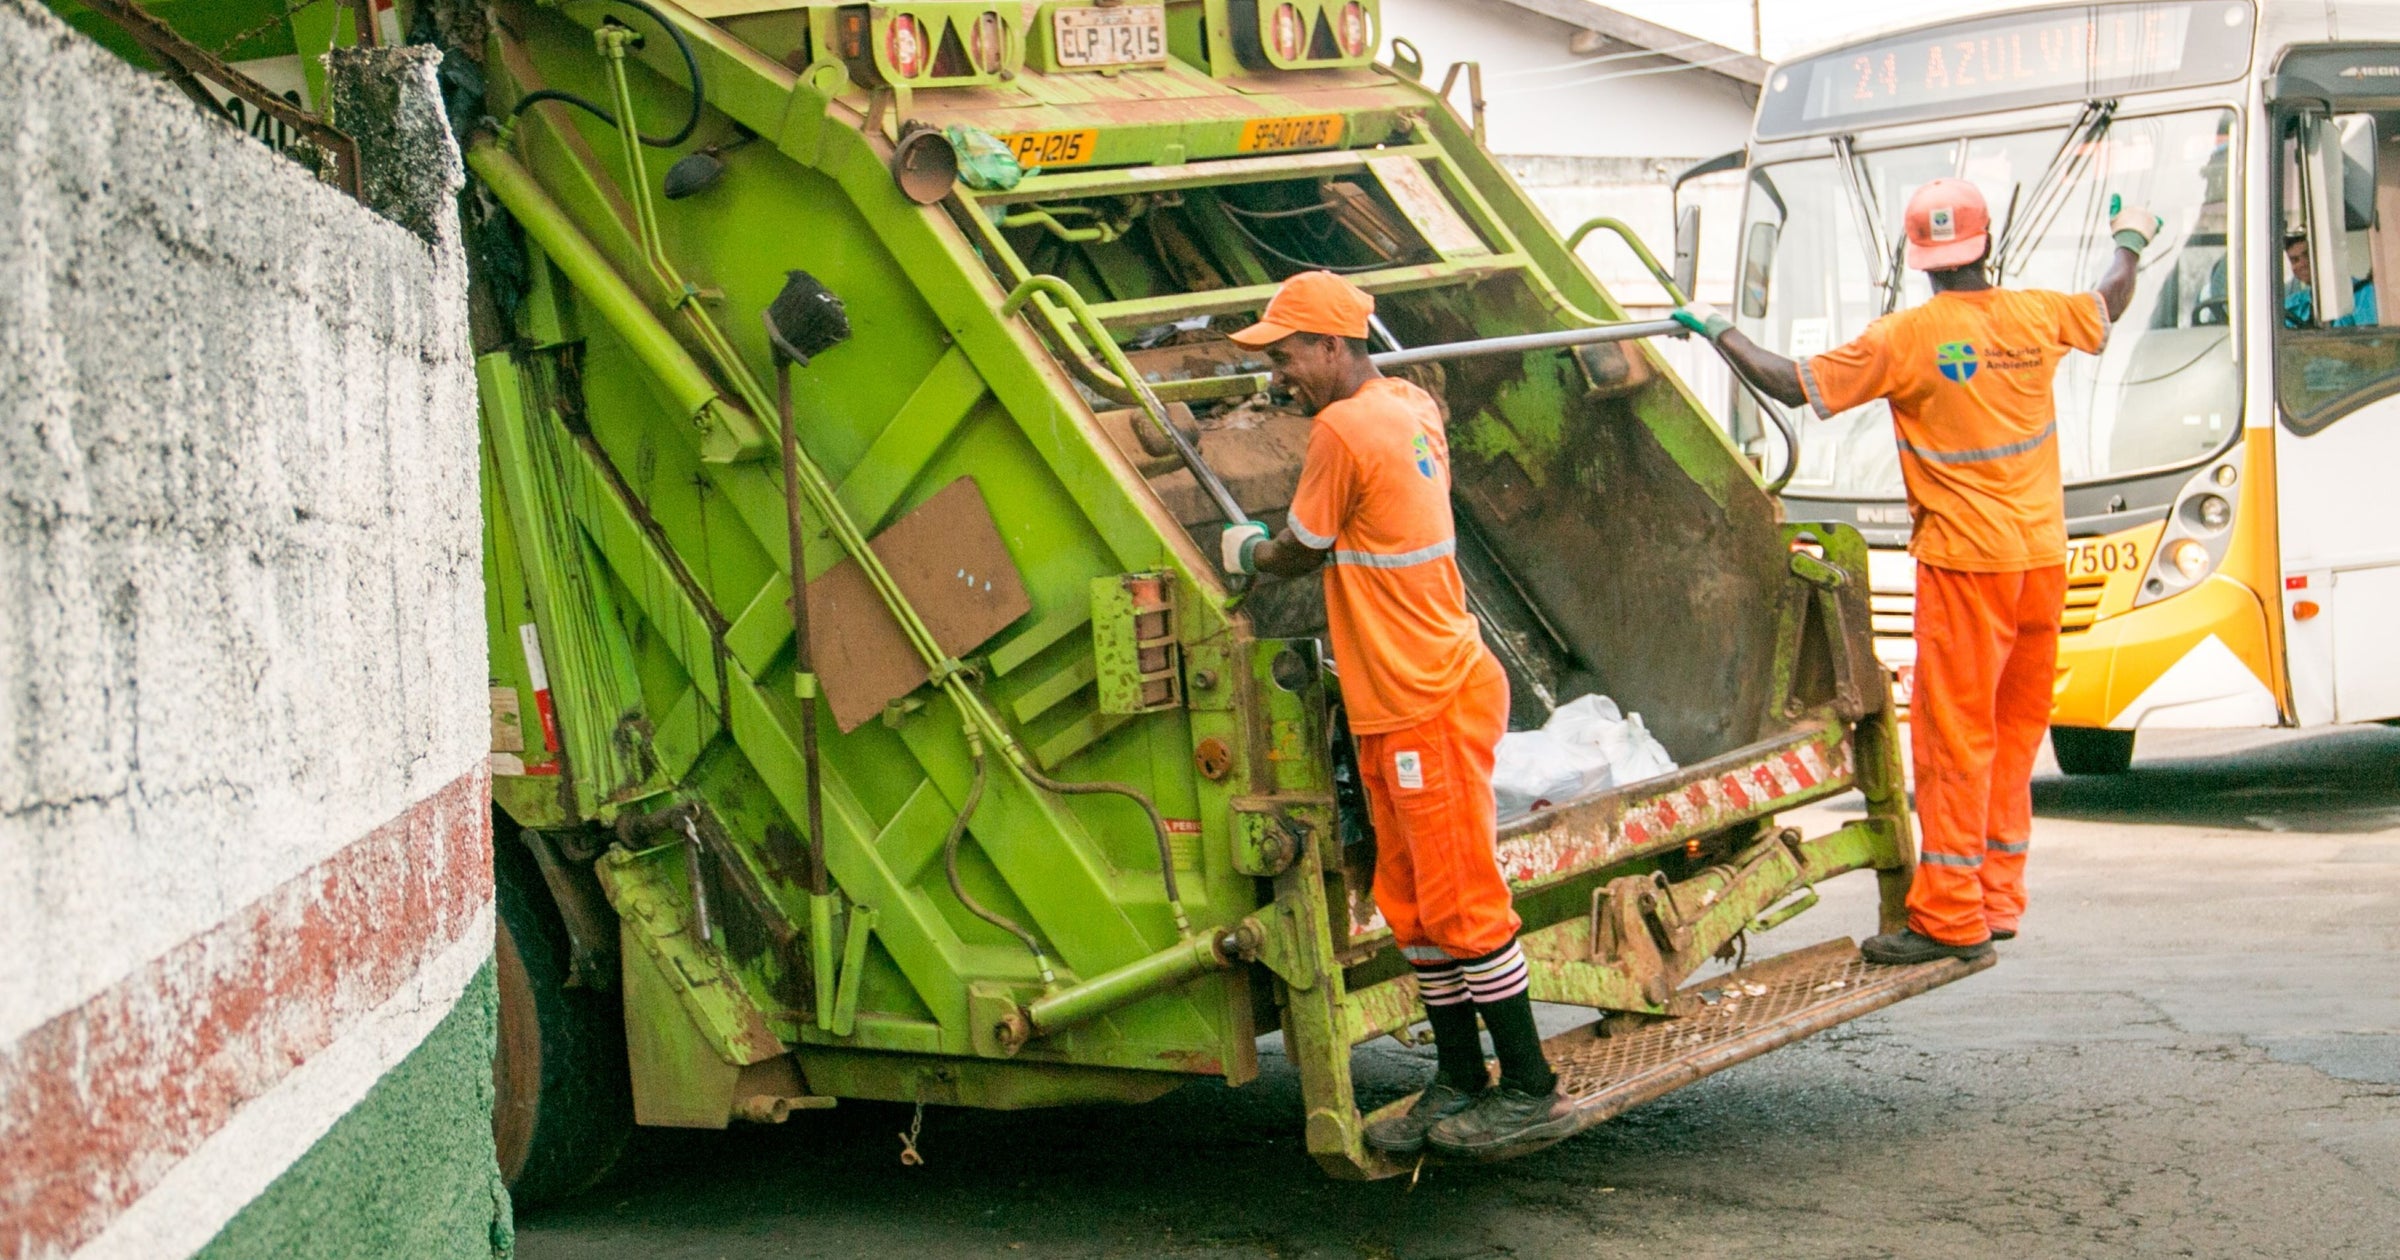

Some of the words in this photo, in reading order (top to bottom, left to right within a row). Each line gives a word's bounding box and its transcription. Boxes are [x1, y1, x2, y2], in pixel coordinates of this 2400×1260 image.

[1109, 25, 1160, 55] 1215
[1853, 53, 1898, 99] 24
[1925, 13, 2166, 89] AZULVILLE
[1986, 357, 2043, 369] Ambiental
[2068, 543, 2139, 574] 7503
